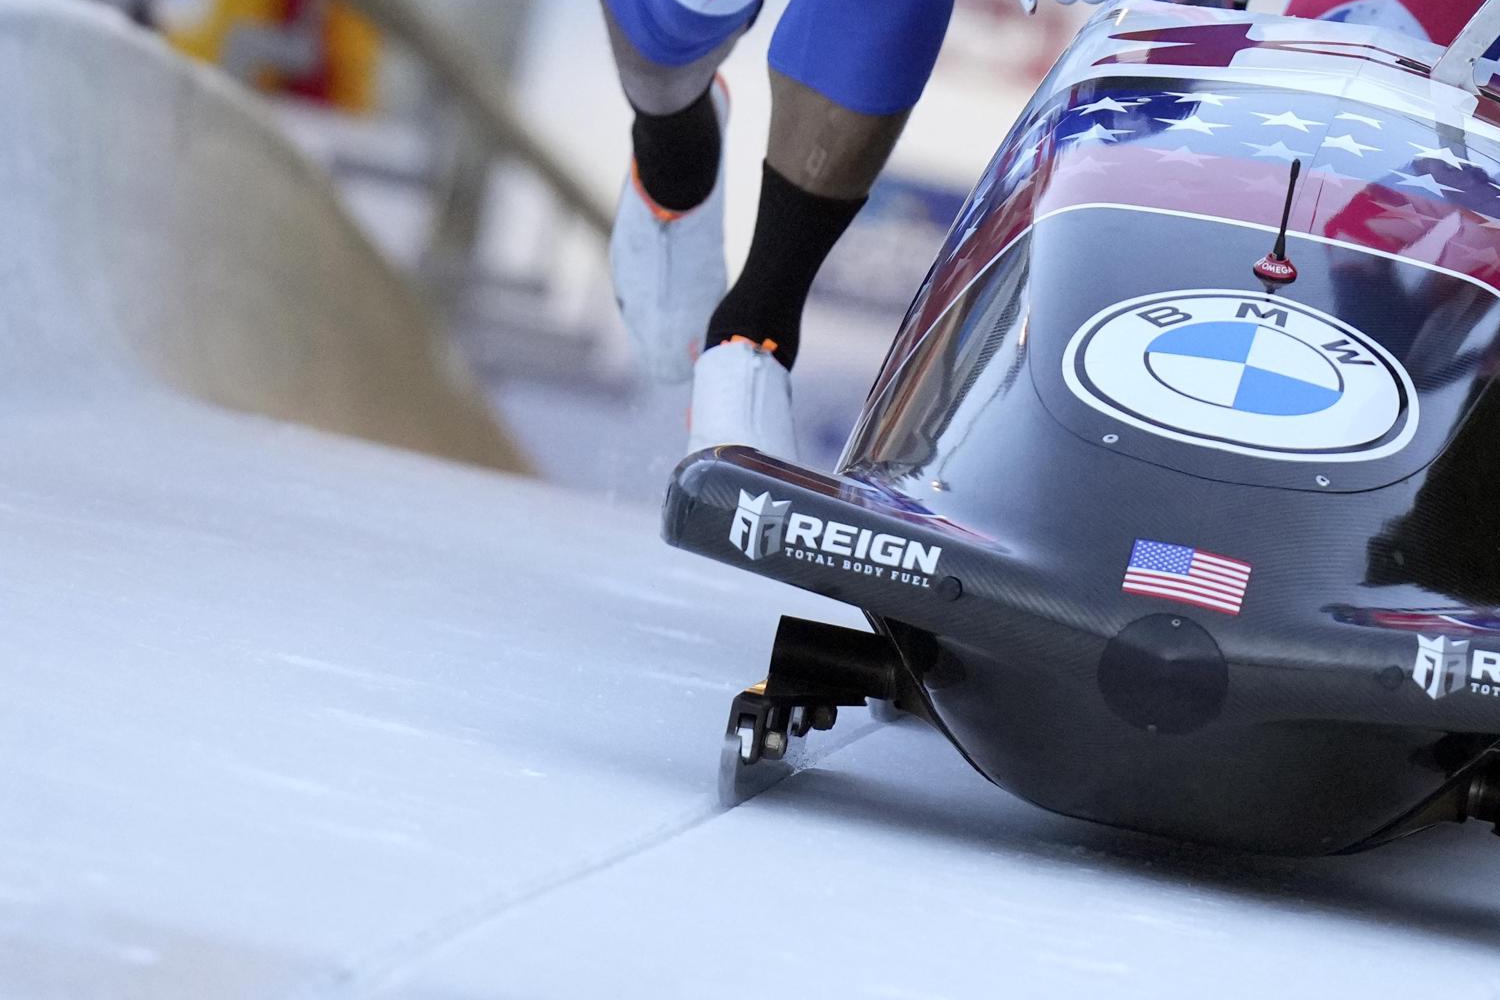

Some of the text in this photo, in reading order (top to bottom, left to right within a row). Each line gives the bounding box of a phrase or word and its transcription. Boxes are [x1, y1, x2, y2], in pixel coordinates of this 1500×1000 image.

[1261, 262, 1294, 275] OMEGA
[1135, 302, 1377, 367] BMW
[784, 512, 943, 575] REIGN
[784, 547, 931, 588] TOTAL BODY FUEL
